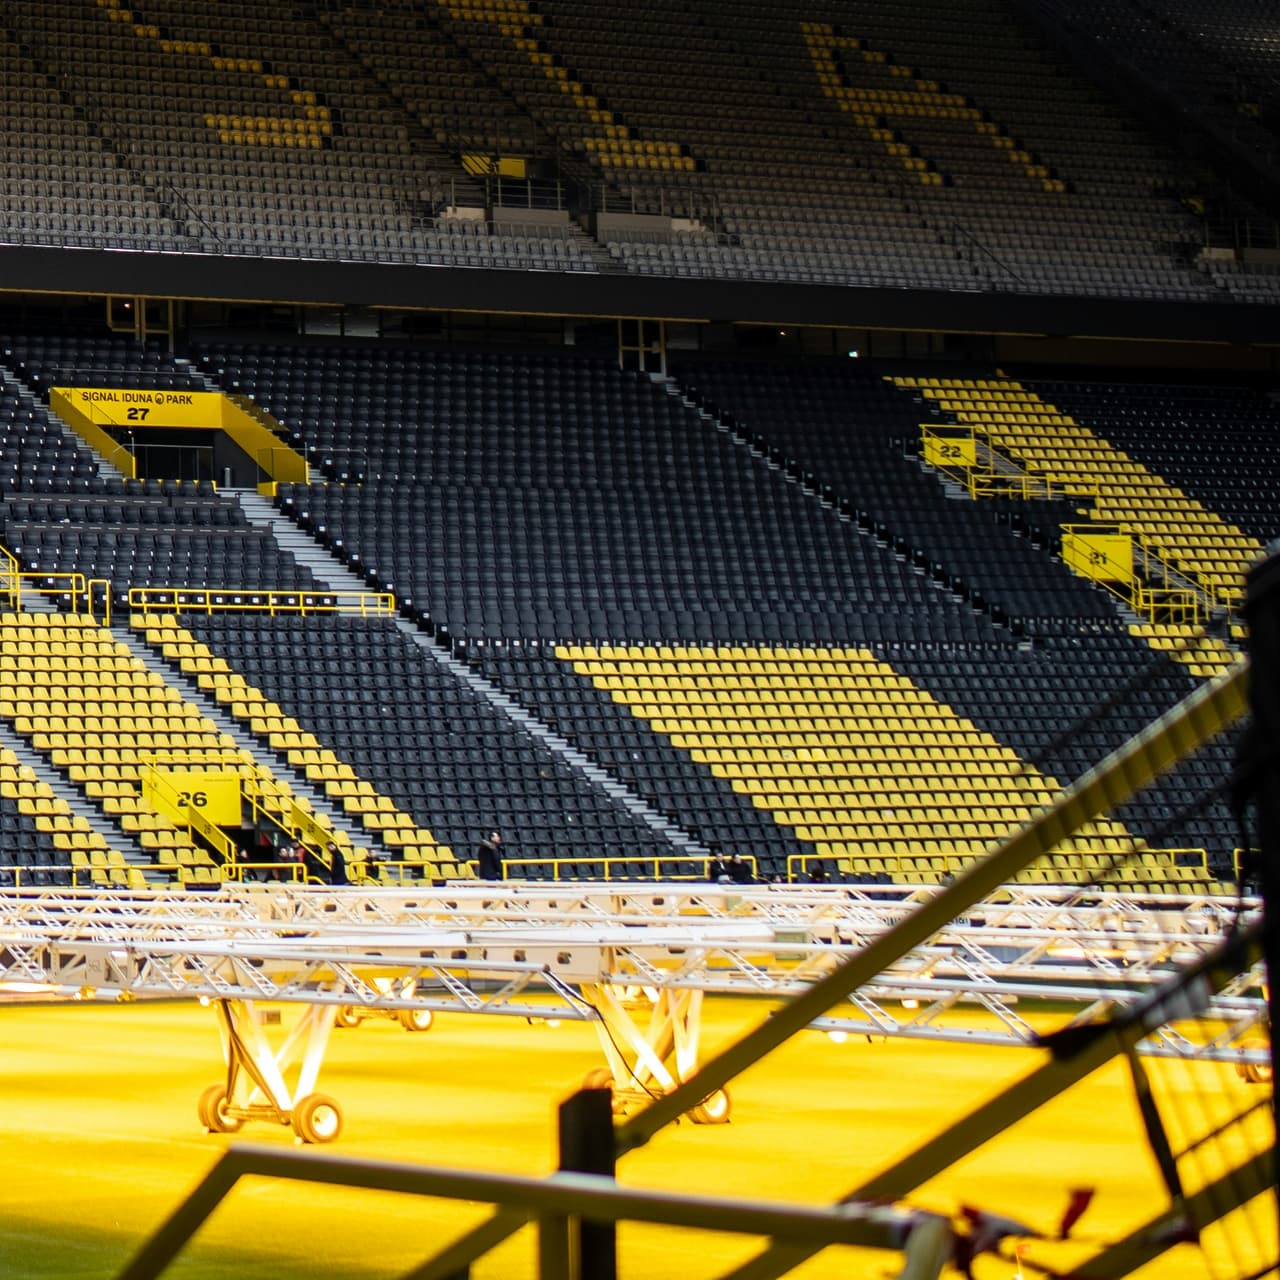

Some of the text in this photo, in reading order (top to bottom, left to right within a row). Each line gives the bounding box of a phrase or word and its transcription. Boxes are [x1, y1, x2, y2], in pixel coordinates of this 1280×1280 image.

[82, 391, 193, 405] SIGNAL IDUNA PARK
[127, 408, 150, 420] 27
[939, 445, 961, 459] 22
[1088, 551, 1107, 565] 21
[177, 791, 208, 808] 26
